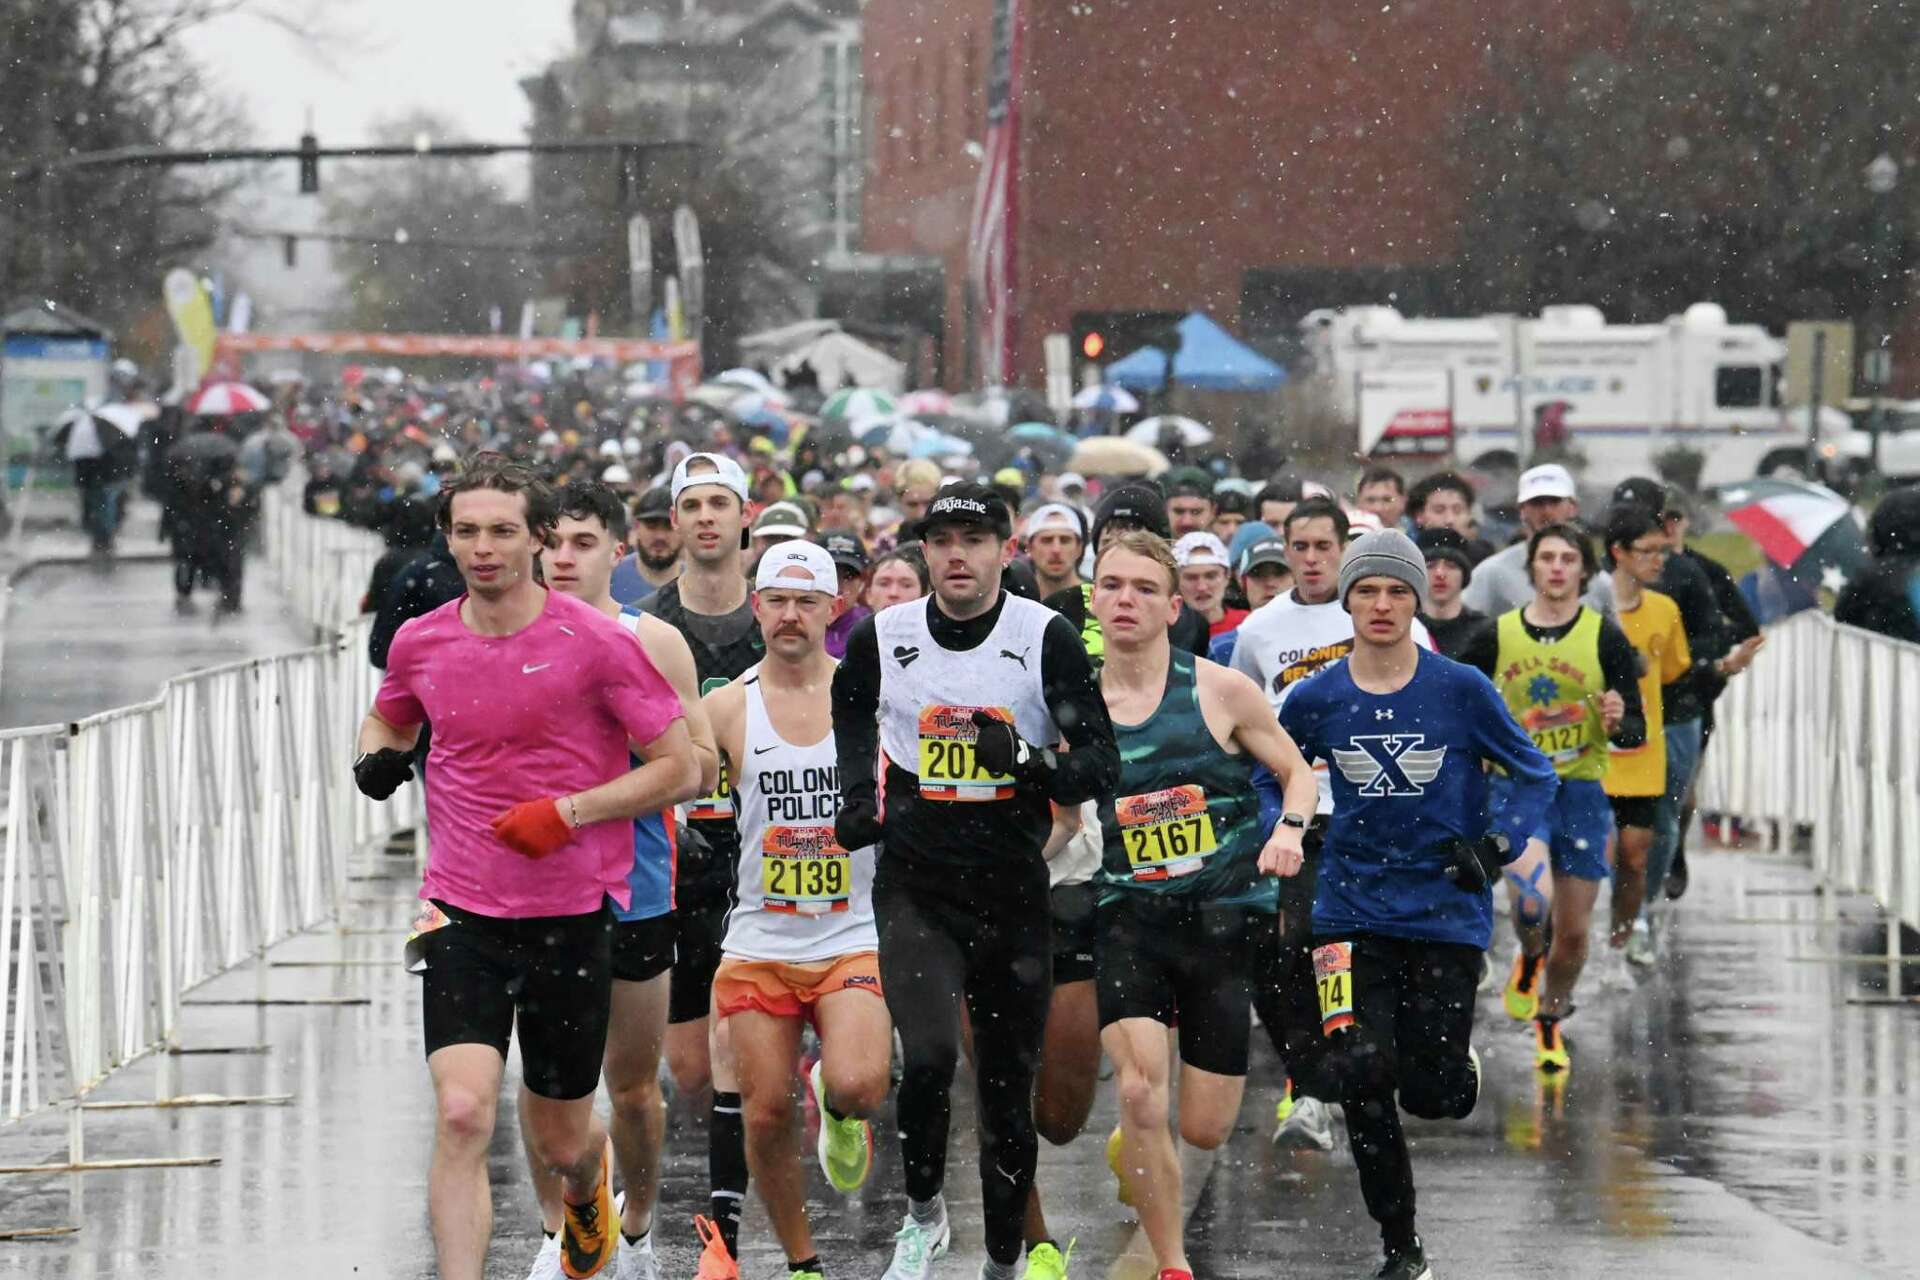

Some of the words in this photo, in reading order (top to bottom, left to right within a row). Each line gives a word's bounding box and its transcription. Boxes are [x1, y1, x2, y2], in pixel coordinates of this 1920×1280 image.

[931, 497, 986, 514] magazine
[1532, 723, 1583, 752] 2127
[927, 741, 1006, 780] 207
[758, 765, 840, 795] COLONI
[775, 833, 837, 850] TURKEY
[1131, 818, 1202, 863] 2167
[770, 859, 842, 895] 2139
[1317, 975, 1345, 1013] 74
